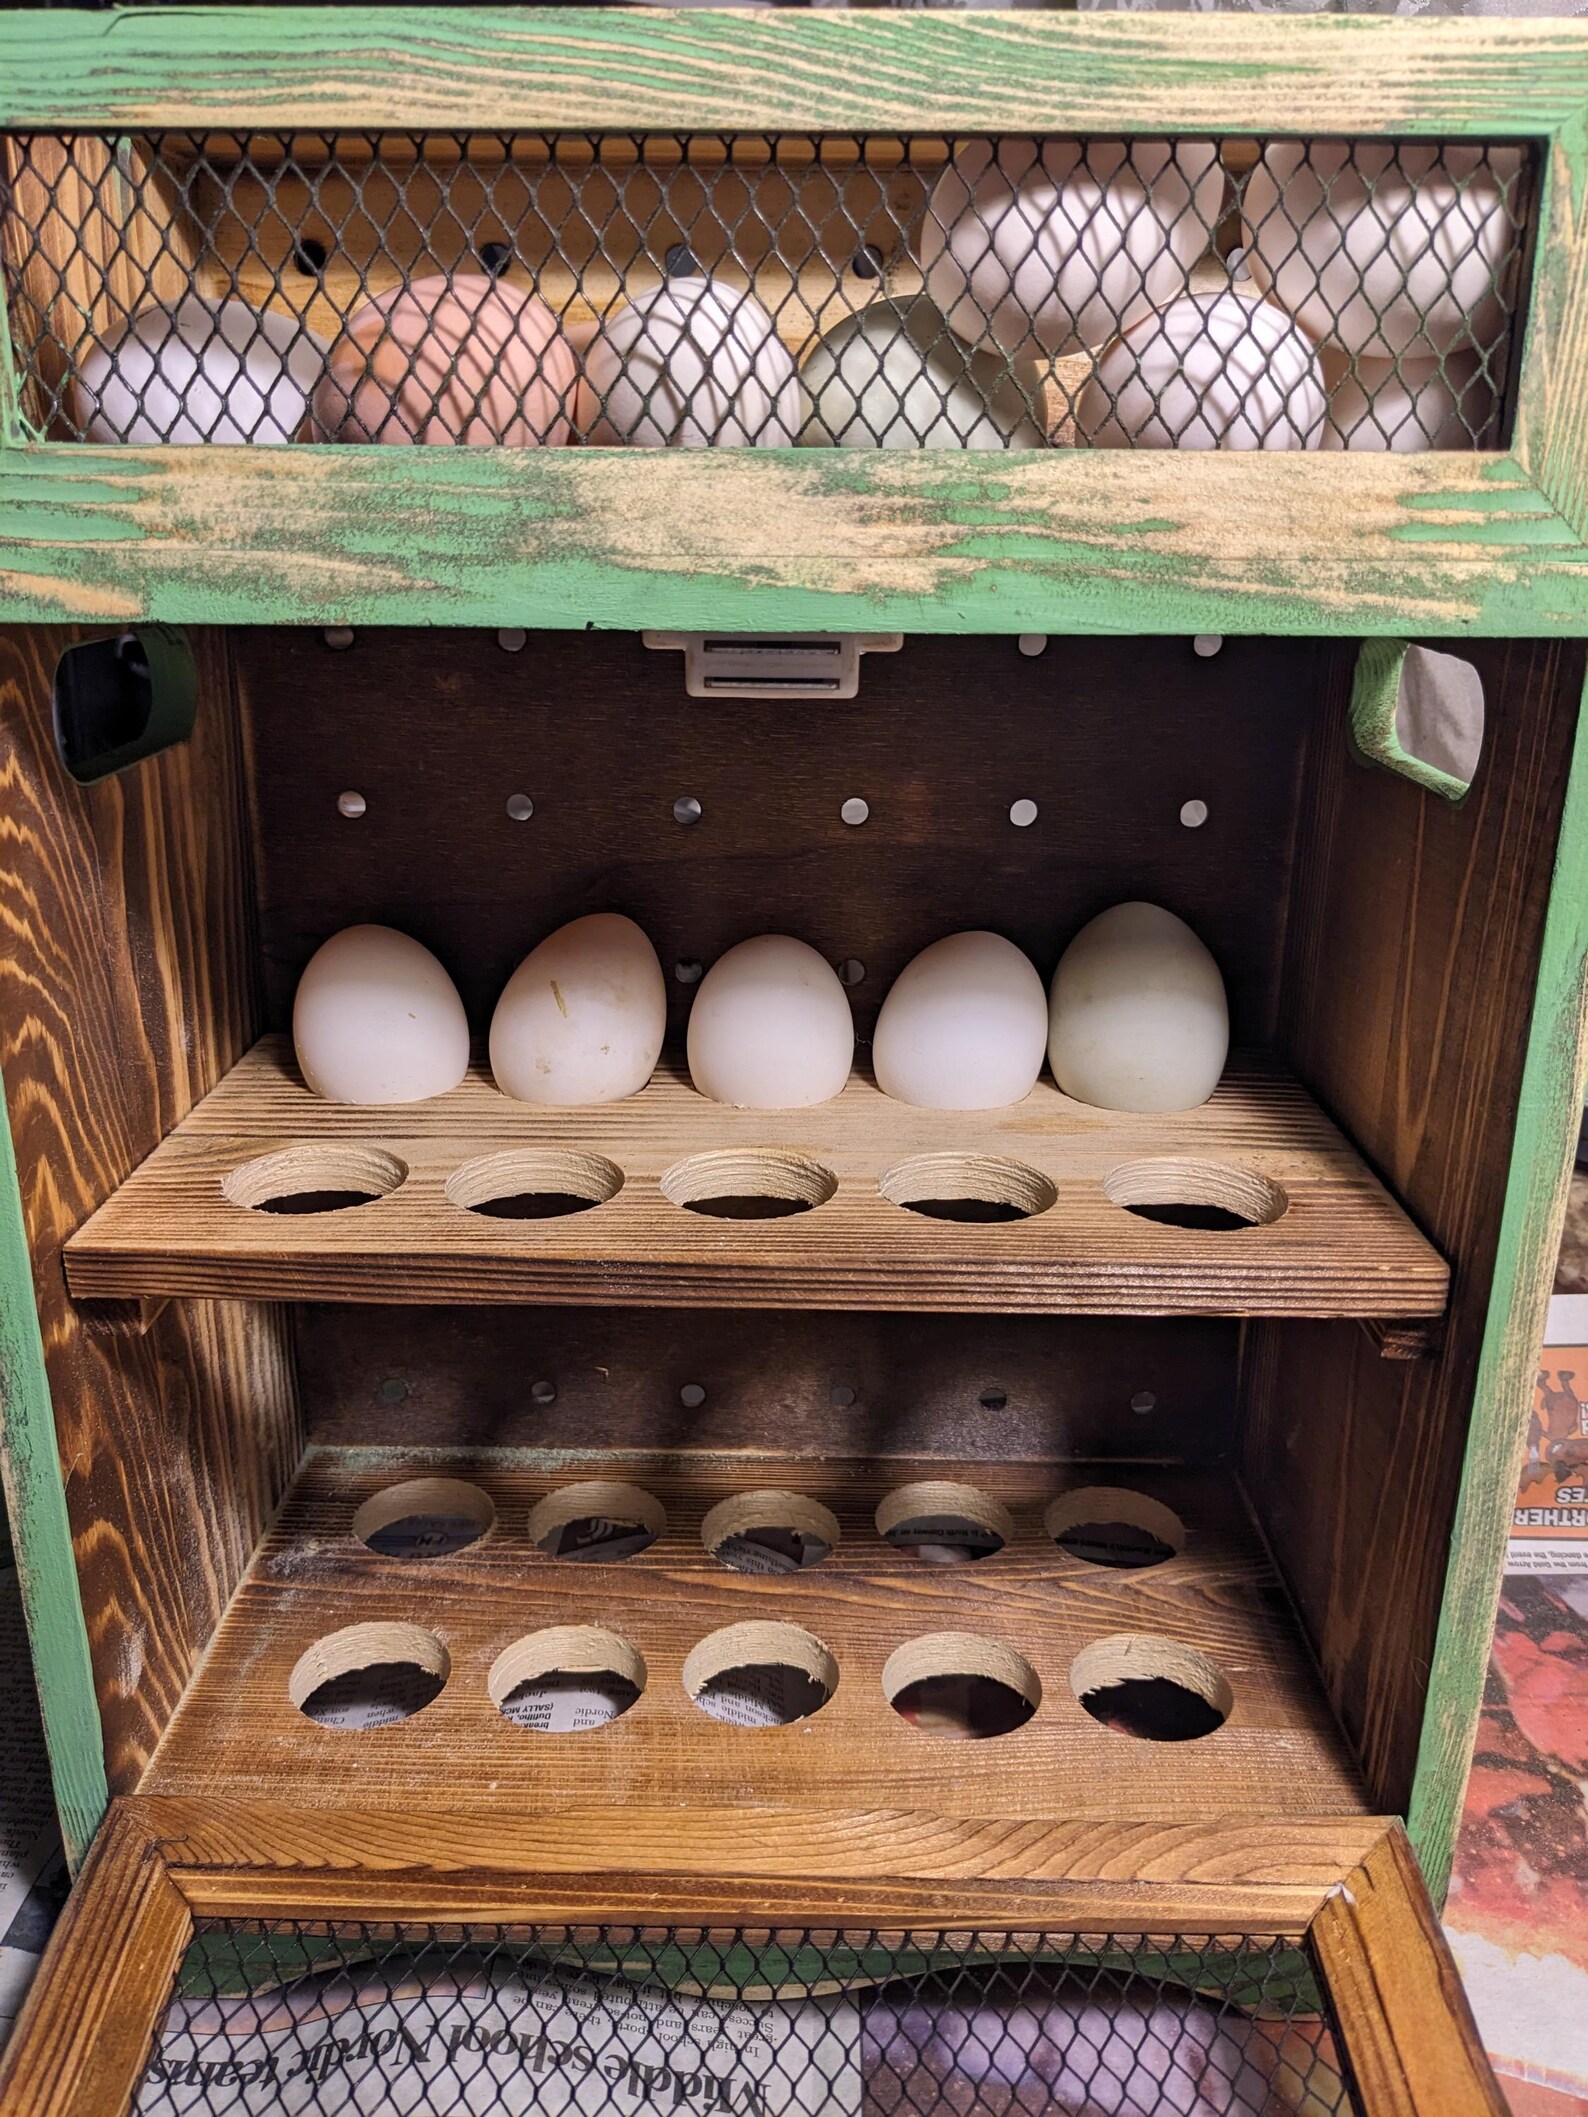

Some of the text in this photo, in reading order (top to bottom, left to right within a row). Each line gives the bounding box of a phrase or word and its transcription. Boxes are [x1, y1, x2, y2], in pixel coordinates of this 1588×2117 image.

[522, 1702, 554, 1713] (SALLY
[721, 1696, 740, 1708] and
[367, 1708, 394, 1718] when
[575, 1707, 614, 1720] Nordic
[721, 1706, 757, 1724] middle
[362, 1715, 399, 1728] middle
[573, 1718, 596, 1727] and
[656, 2019, 682, 2031] and
[287, 2025, 433, 2086] Nordic
[447, 2024, 594, 2074] school
[603, 2054, 771, 2117] Middle
